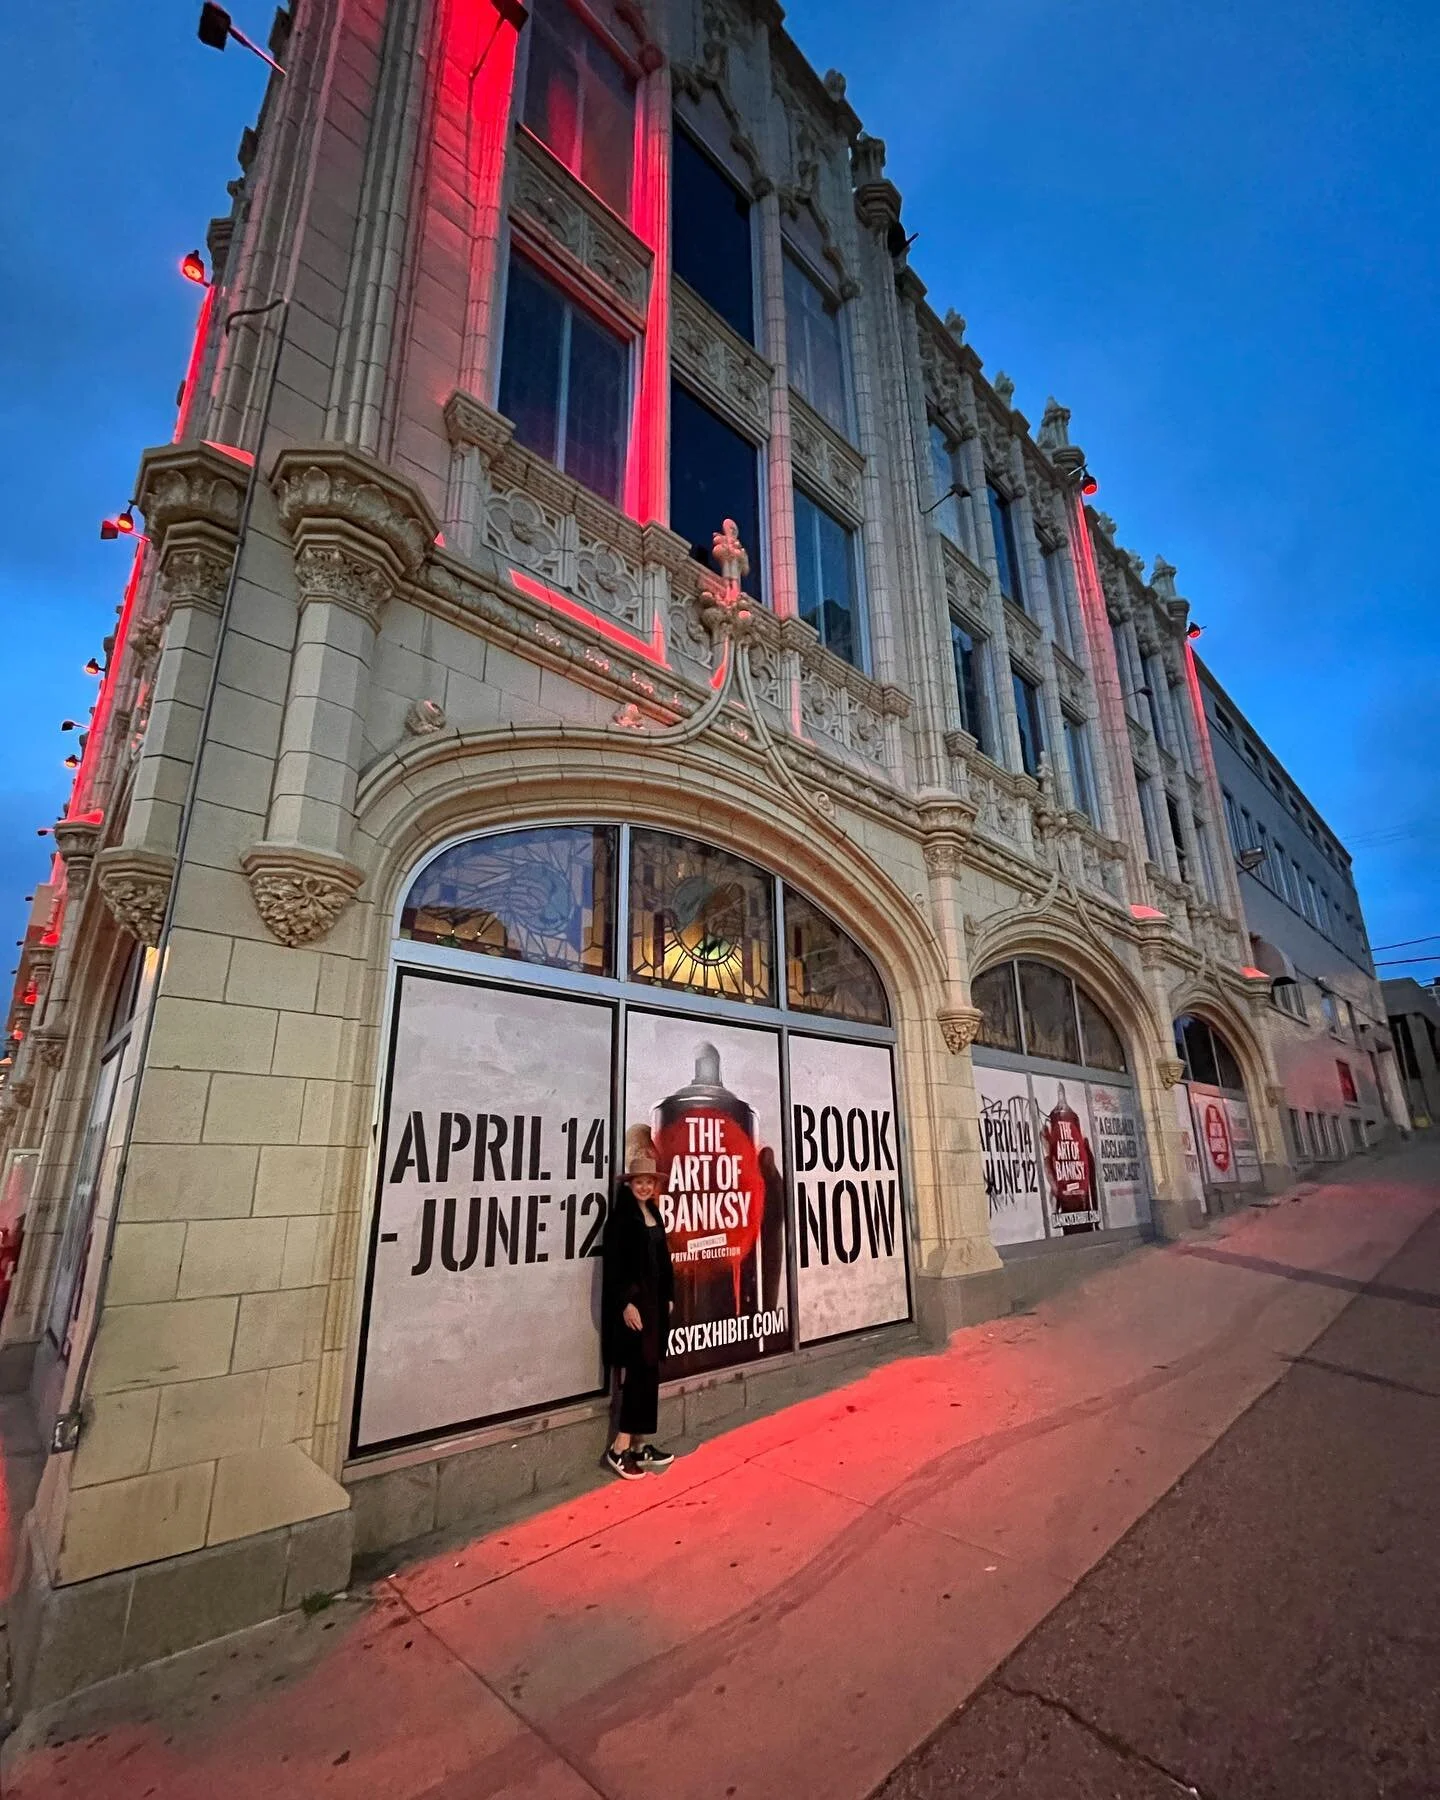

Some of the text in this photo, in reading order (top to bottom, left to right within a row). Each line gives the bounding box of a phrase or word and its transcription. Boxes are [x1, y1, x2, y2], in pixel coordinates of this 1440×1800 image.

[390, 1111, 608, 1183] APRIL 14
[685, 1117, 726, 1153] THE
[793, 1104, 895, 1173] BOOK
[1058, 1121, 1074, 1141] THE
[1056, 1141, 1080, 1161] ART OF
[668, 1155, 743, 1193] ART OF
[1022, 1160, 1038, 1193] 12
[1055, 1160, 1086, 1182] BANKSY
[659, 1191, 752, 1234] BANKSY
[797, 1179, 896, 1268] NOW
[411, 1194, 551, 1276] JUNE
[560, 1192, 607, 1260] 12
[671, 1246, 741, 1263] PRIVATE COLLECTION
[666, 1309, 784, 1357] KSYEXHIBIT.COM
